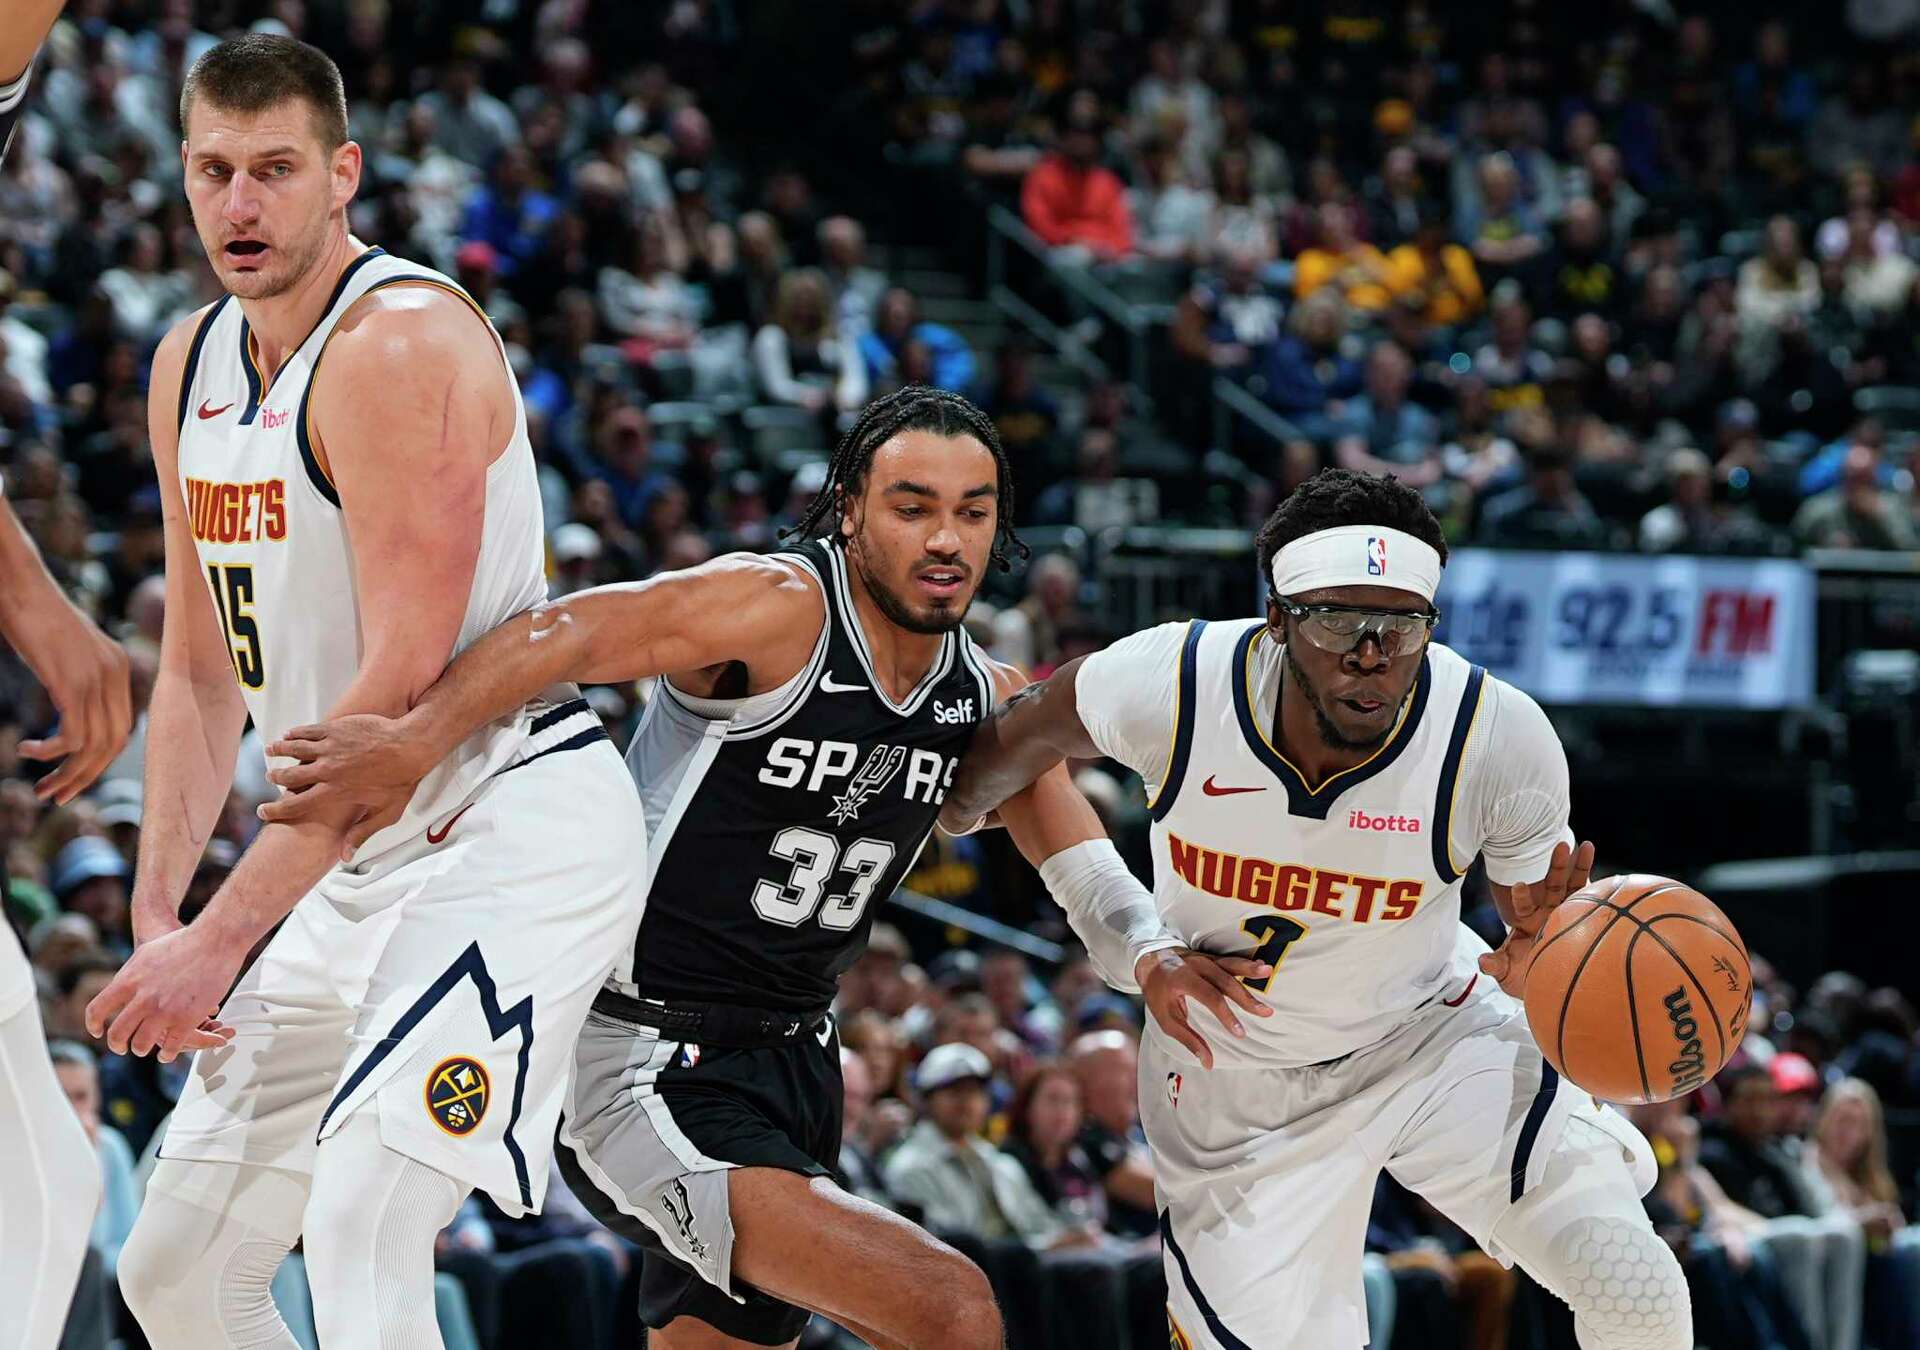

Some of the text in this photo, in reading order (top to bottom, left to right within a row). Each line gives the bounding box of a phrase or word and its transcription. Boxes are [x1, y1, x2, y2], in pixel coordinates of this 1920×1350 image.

[206, 561, 265, 691] 15
[1560, 584, 1682, 651] 92.5
[1697, 588, 1777, 657] FM
[1349, 810, 1420, 832] ibotta
[750, 826, 896, 931] 33
[1168, 830, 1424, 924] NUGGETS
